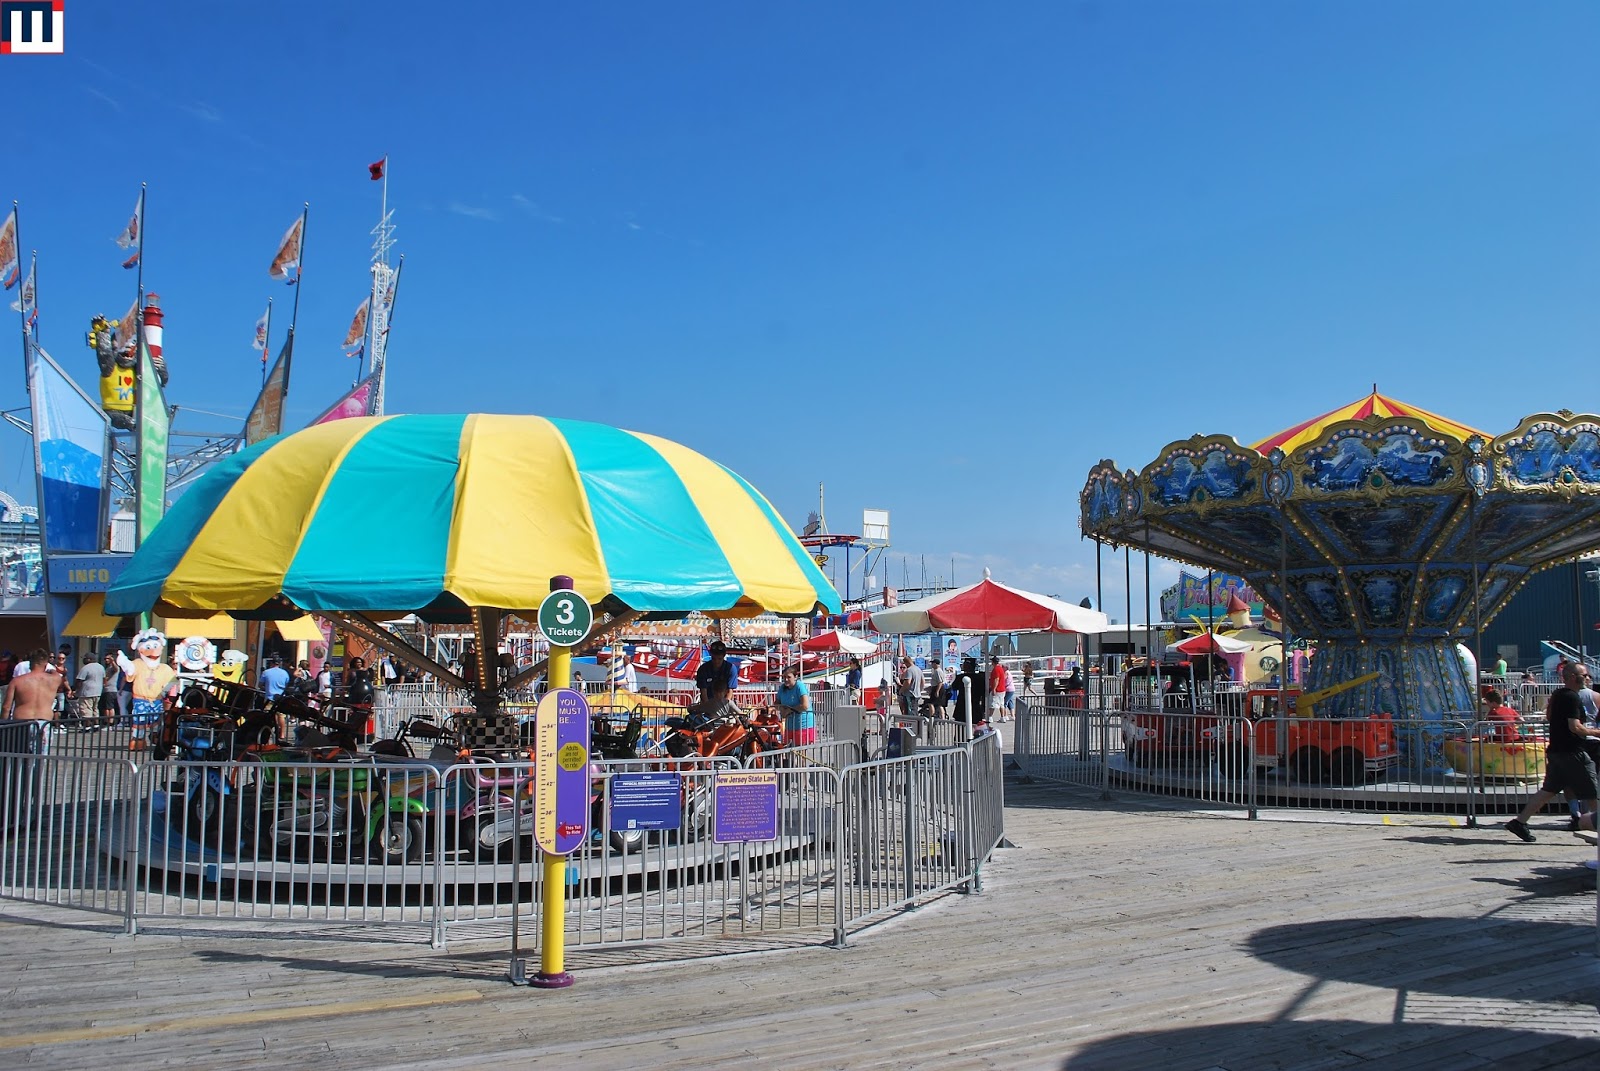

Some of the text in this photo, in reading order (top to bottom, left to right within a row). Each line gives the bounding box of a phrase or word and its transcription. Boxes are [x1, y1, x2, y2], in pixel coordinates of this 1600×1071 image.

[68, 568, 110, 583] INFO
[1183, 586, 1224, 609] Duck
[555, 599, 575, 625] 3
[547, 627, 583, 637] Tickets
[559, 699, 577, 707] YOU
[559, 707, 582, 715] MUST
[559, 716, 576, 724] BE...
[716, 774, 776, 785] New Jersey State Law!
